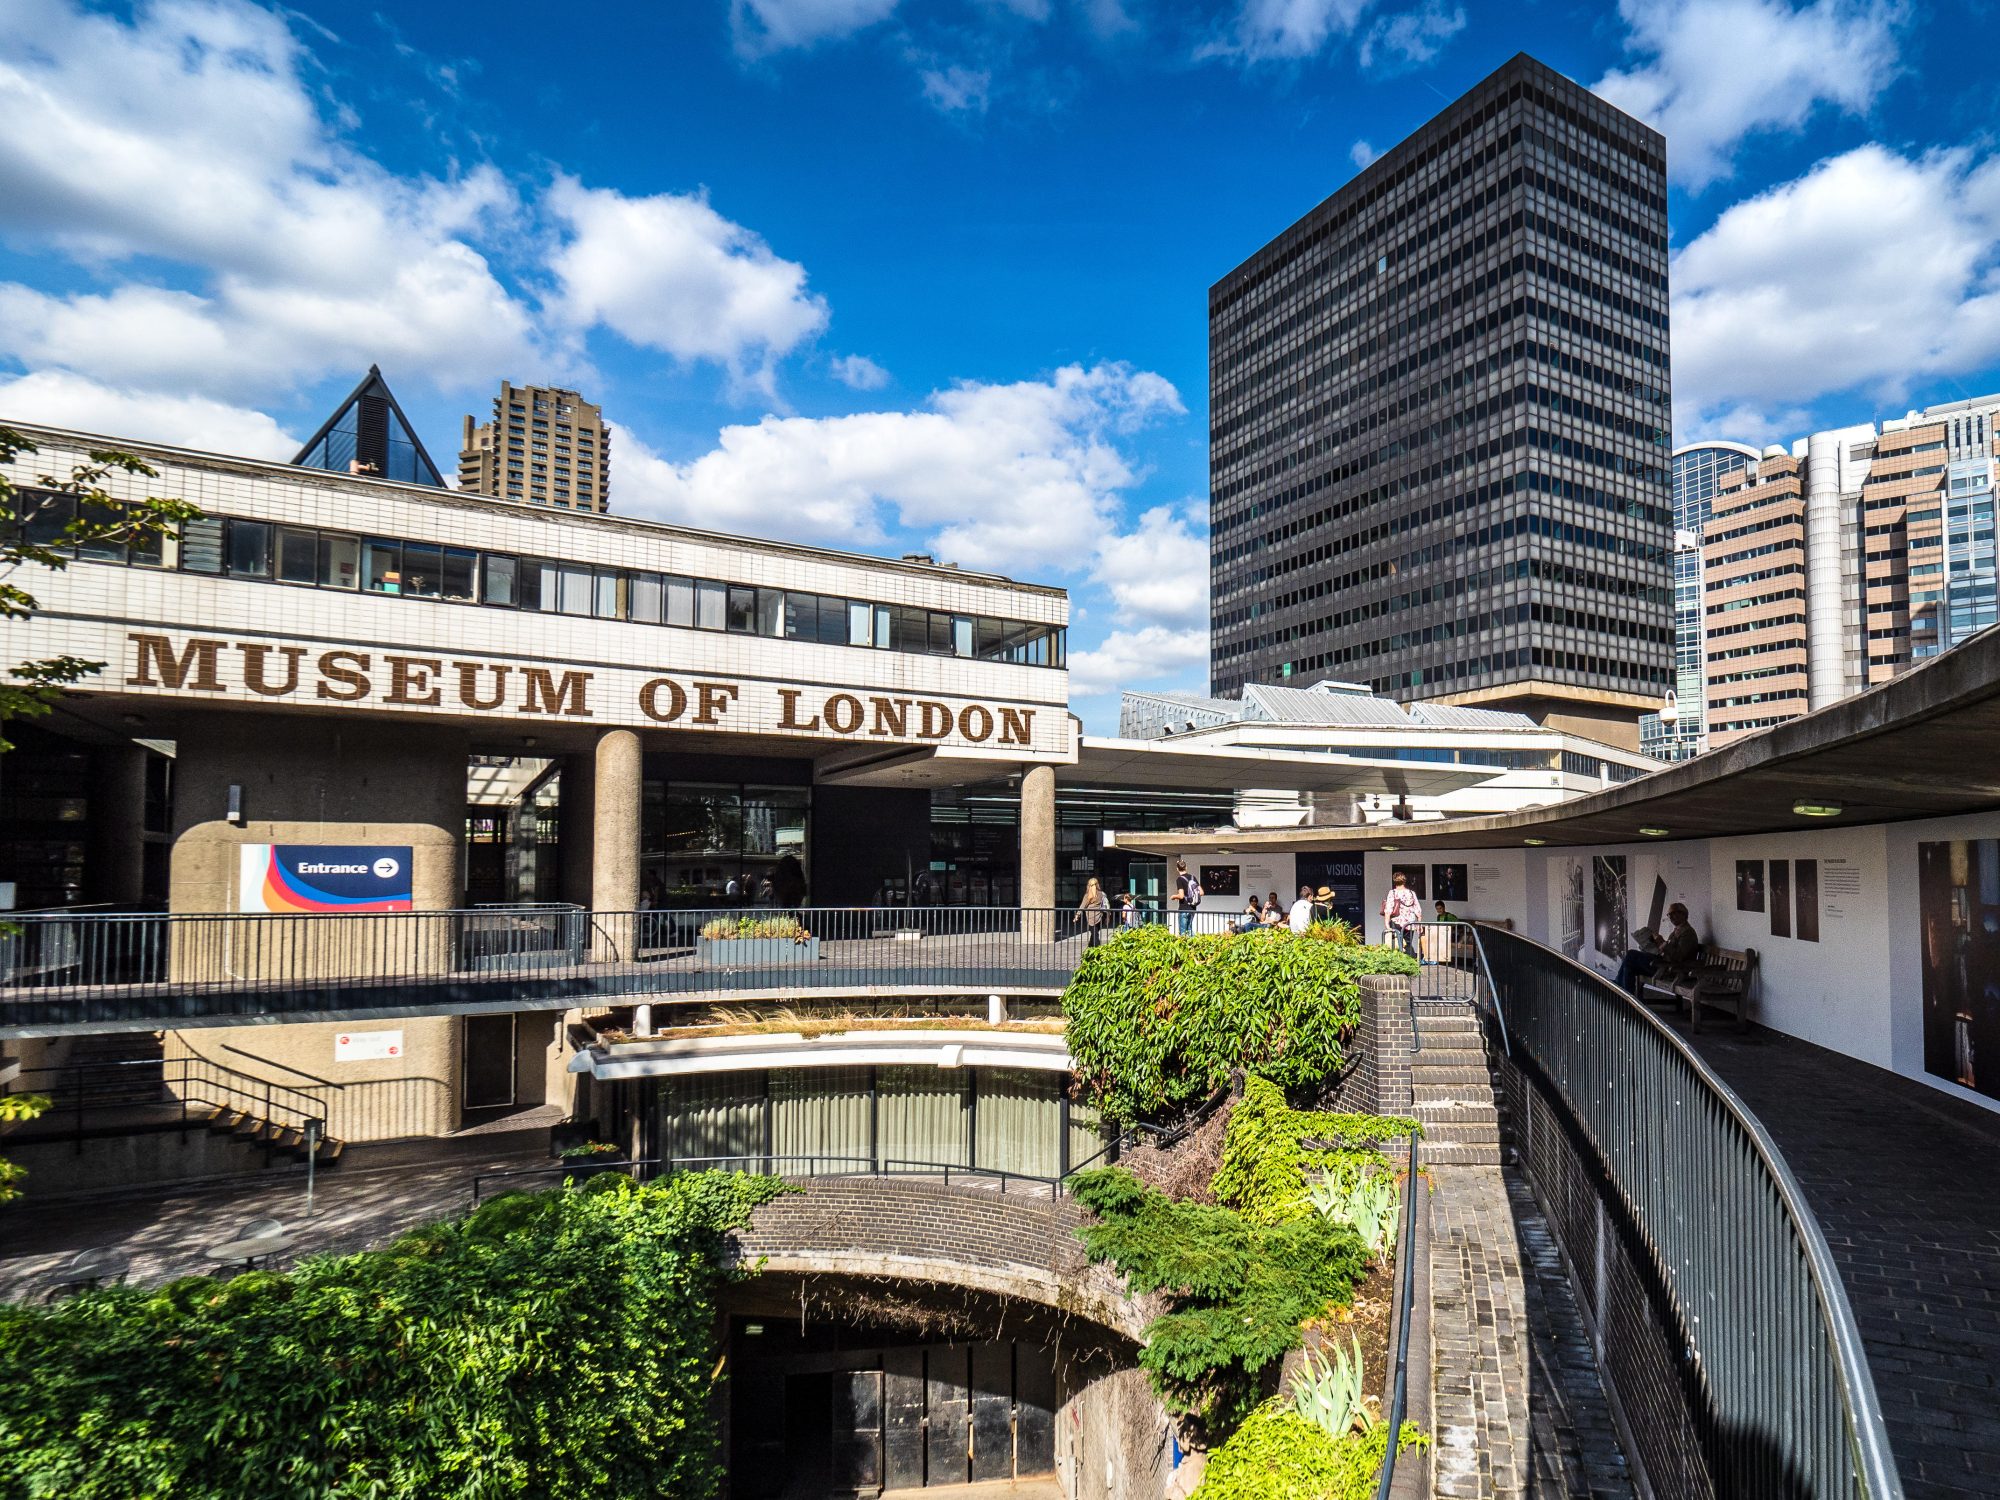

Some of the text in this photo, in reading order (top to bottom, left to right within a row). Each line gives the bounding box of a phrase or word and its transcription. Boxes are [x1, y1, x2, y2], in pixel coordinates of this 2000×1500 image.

[126, 633, 1037, 745] MUSEUM OF LONDON
[298, 861, 368, 874] Entrance
